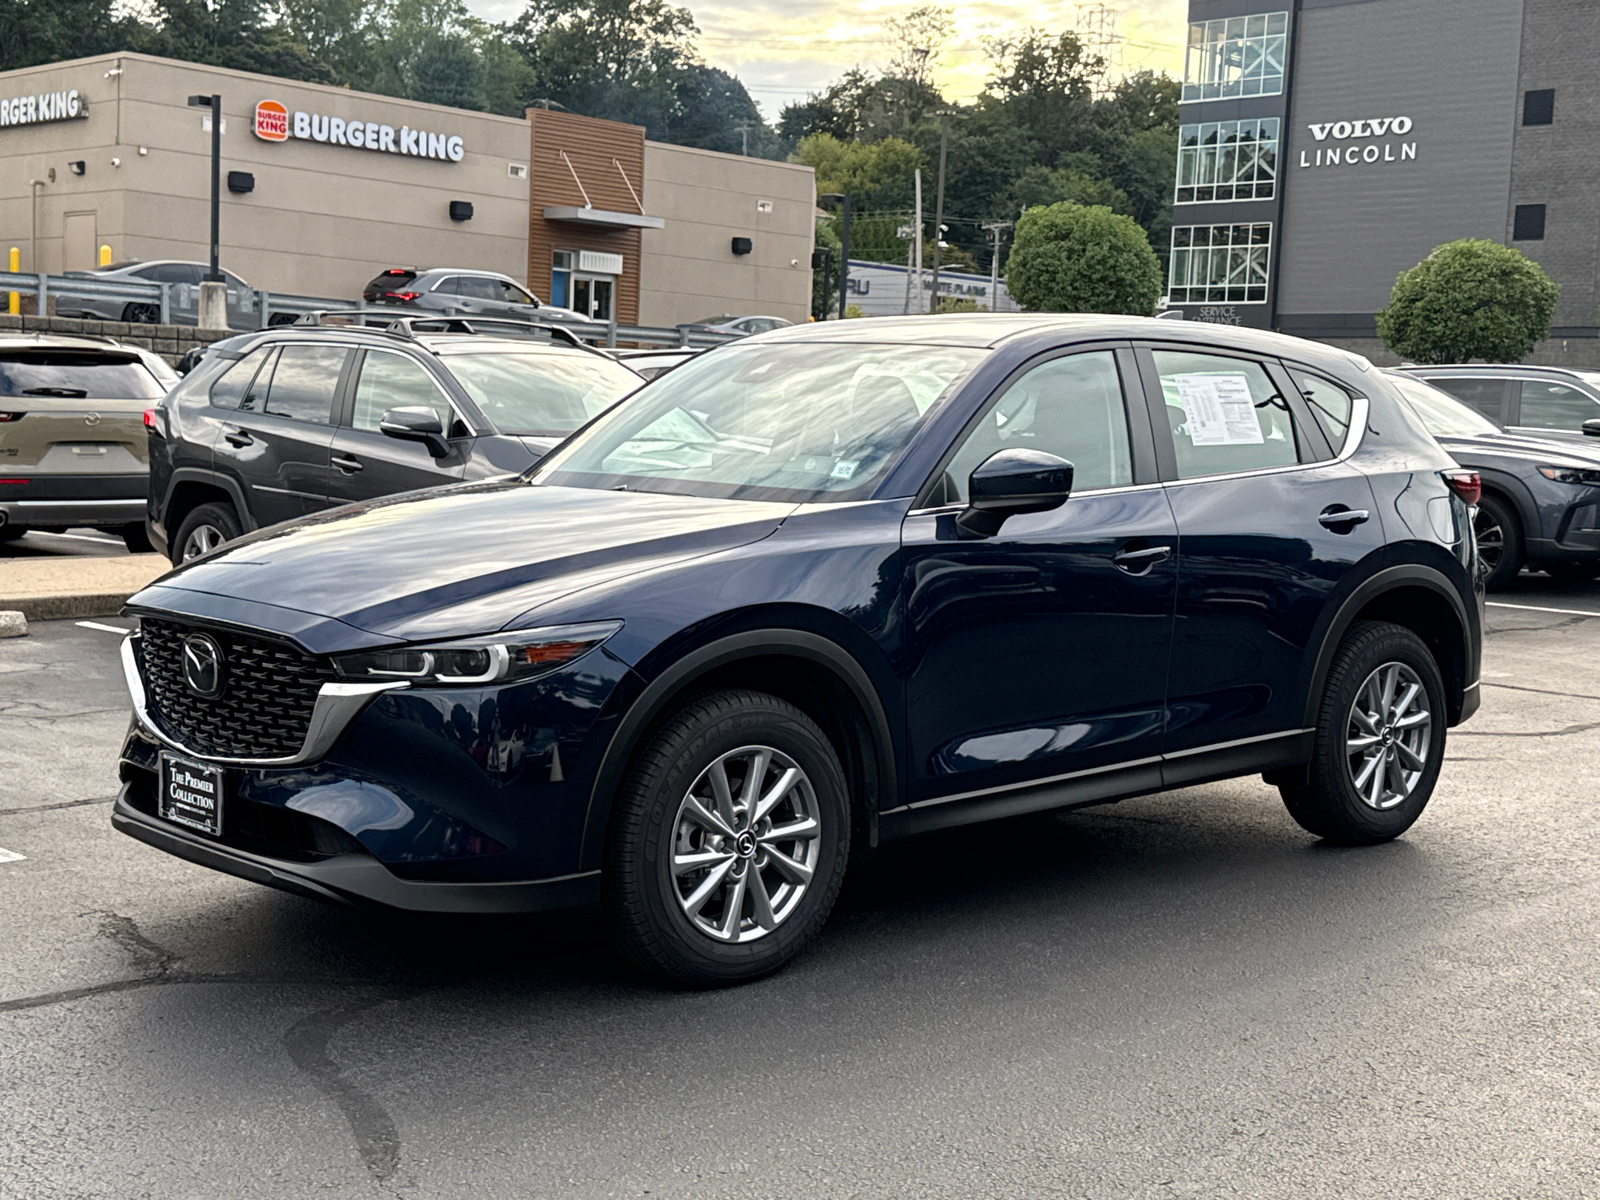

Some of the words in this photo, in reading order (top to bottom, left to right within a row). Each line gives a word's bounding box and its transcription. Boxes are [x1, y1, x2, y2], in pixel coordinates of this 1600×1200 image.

[0, 95, 37, 126] RGER
[39, 89, 79, 121] KING
[257, 110, 287, 122] BURGER
[257, 119, 287, 134] KING
[294, 111, 395, 152] BURGER
[400, 125, 464, 162] KING
[1308, 116, 1413, 141] VOLVO
[1300, 143, 1417, 167] LINCOLN
[845, 279, 870, 296] RU
[922, 279, 953, 294] WITE
[954, 283, 987, 297] PLAINS
[1199, 306, 1237, 317] SERVICE
[170, 768, 185, 784] THE
[185, 772, 214, 794] PREMIER
[170, 783, 214, 810] COLLECTION
